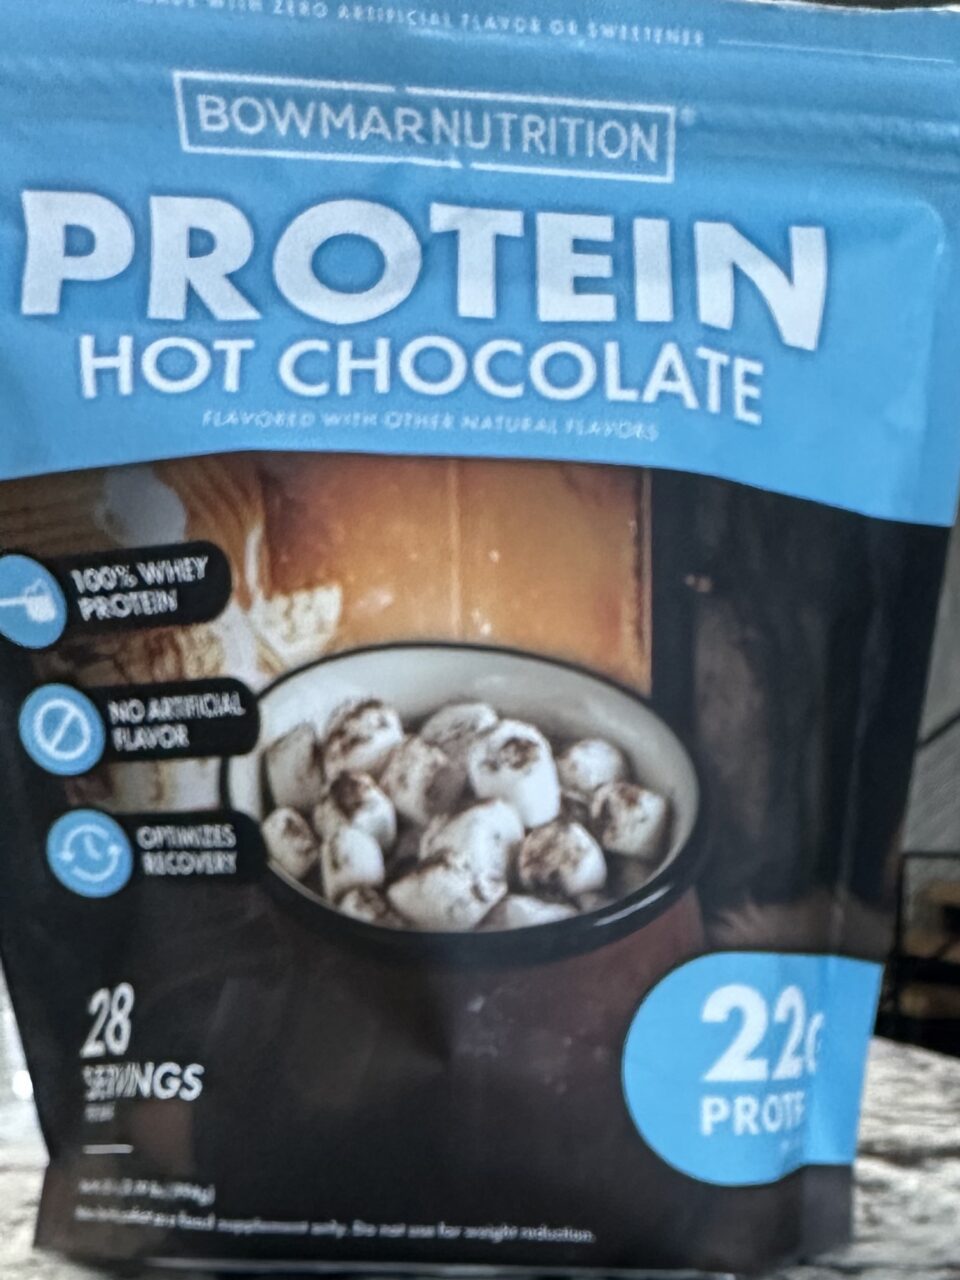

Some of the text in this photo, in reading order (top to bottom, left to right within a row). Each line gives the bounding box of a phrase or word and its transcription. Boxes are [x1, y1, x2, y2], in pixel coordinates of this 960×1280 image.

[273, 0, 328, 18] ZERO
[461, 13, 541, 33] FLAVOR
[20, 190, 828, 352] PROTEIN
[79, 335, 764, 425] HOT CHOCOLATE
[202, 409, 660, 442] FLAVORED WITH OTHER NATURAL FLAVORS
[70, 555, 208, 594] 100% WHEY
[78, 588, 178, 622] PROTEIN
[108, 691, 247, 725] NO ARTIFICIAL
[111, 723, 190, 751] FLAVOR
[142, 850, 237, 876] RECOVERY
[80, 981, 135, 1058] 28
[702, 1090, 806, 1137] PROTE
